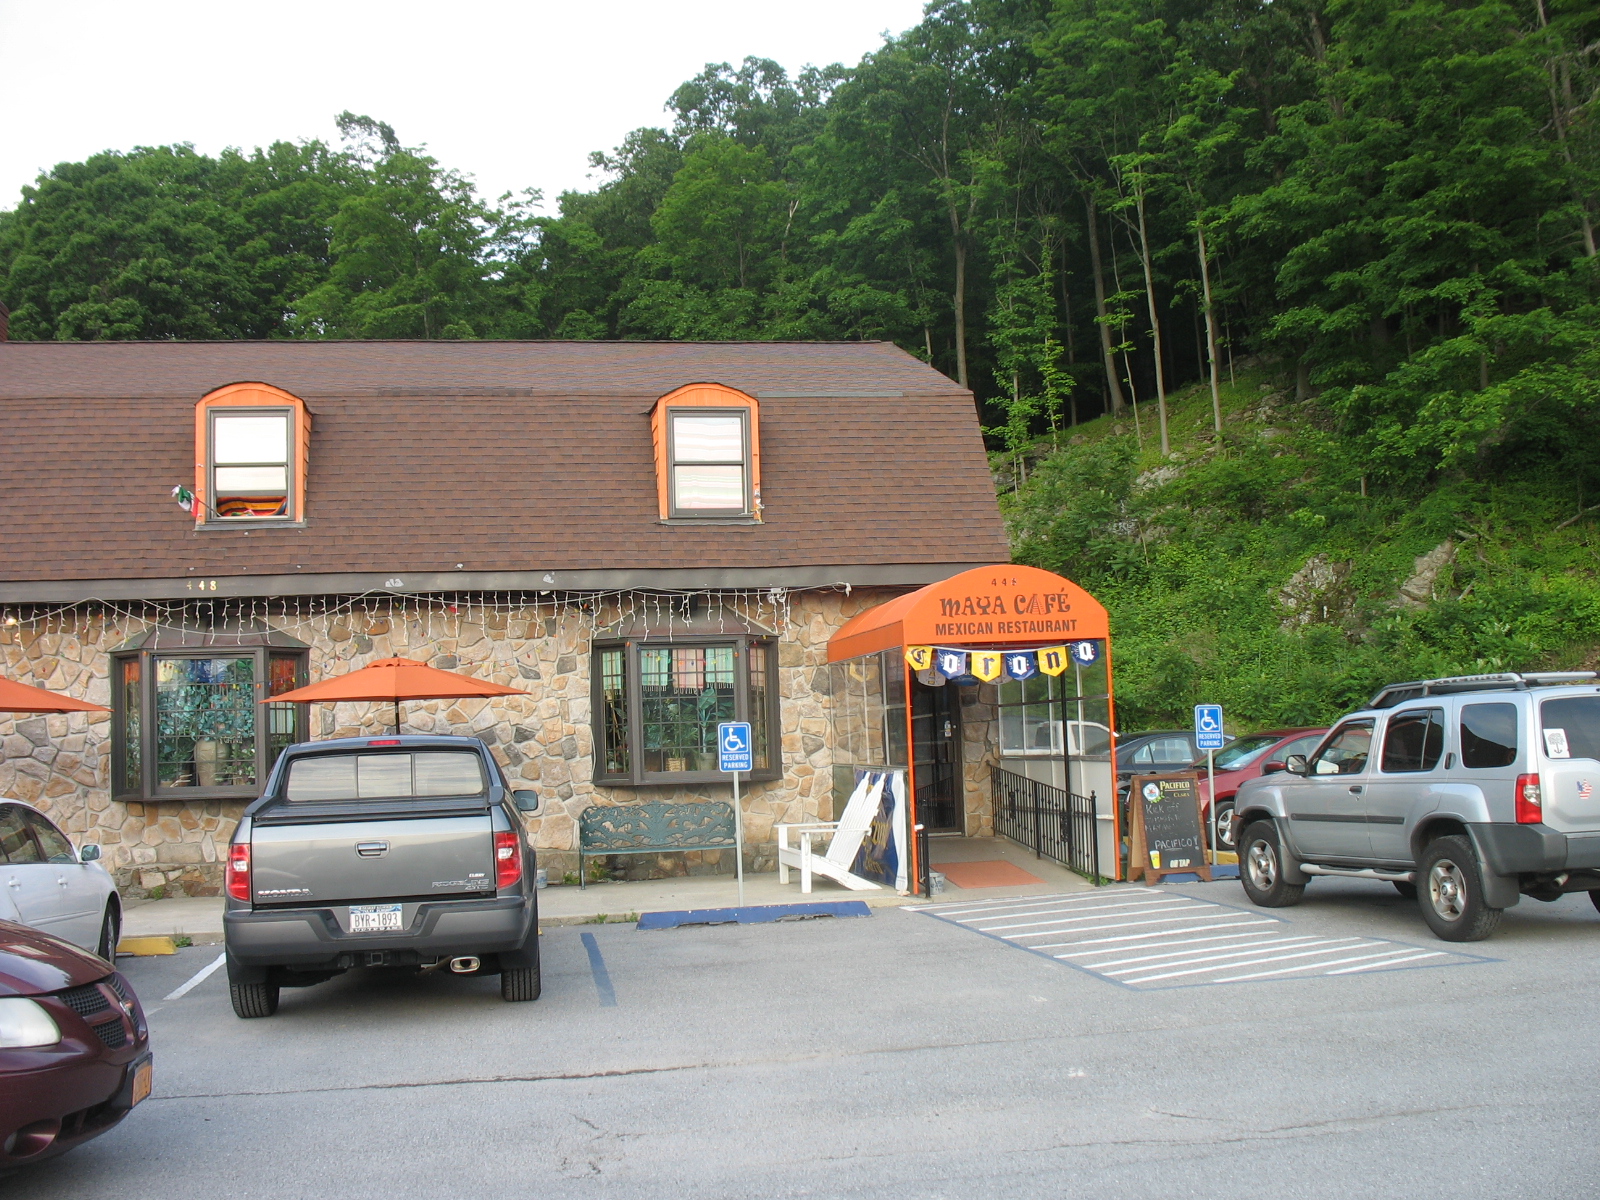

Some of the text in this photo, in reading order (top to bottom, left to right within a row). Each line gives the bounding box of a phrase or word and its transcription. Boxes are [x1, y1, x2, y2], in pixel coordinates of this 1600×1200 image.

[940, 595, 1007, 618] MAYA
[935, 619, 1077, 636] MEXICAN RESTAURANT
